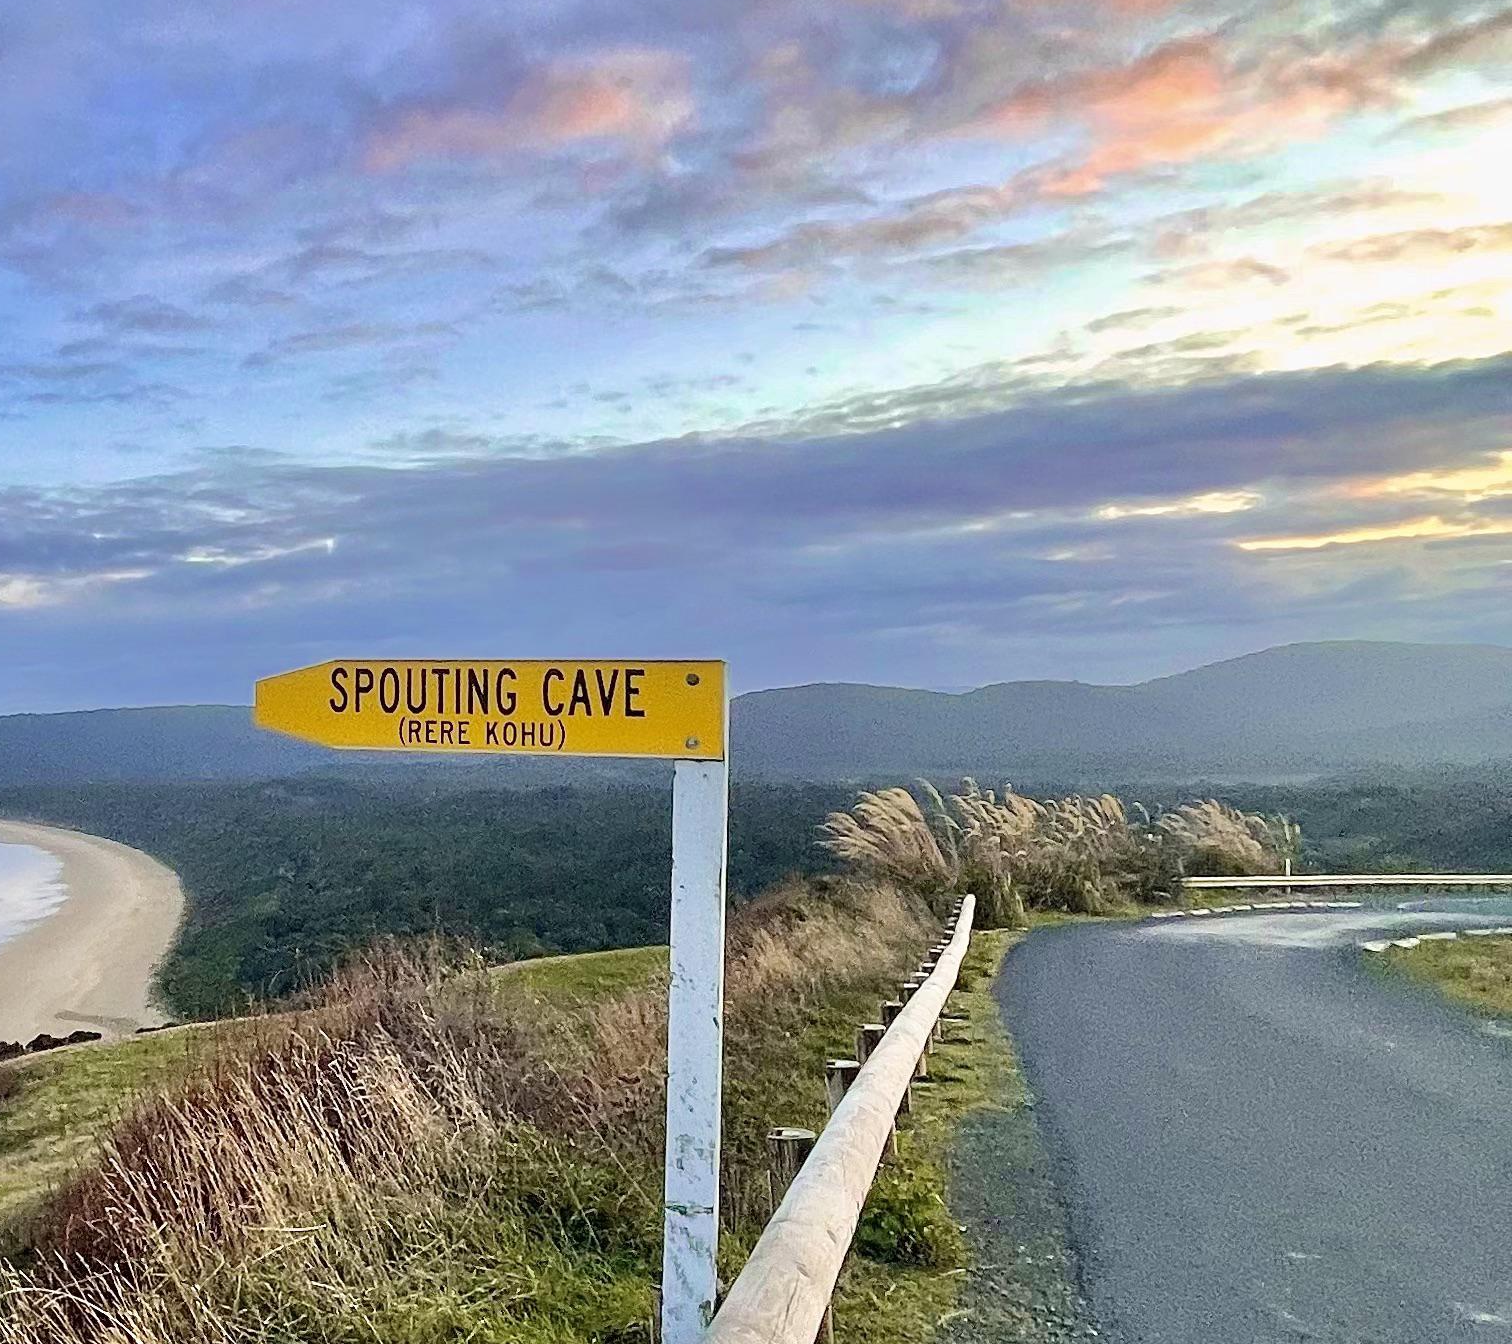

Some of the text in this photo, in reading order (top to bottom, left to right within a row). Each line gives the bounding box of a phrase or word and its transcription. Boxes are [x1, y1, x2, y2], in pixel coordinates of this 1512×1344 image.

[329, 667, 646, 718] SPOUTING CAVE
[398, 716, 567, 750] (RERE KOHU)
